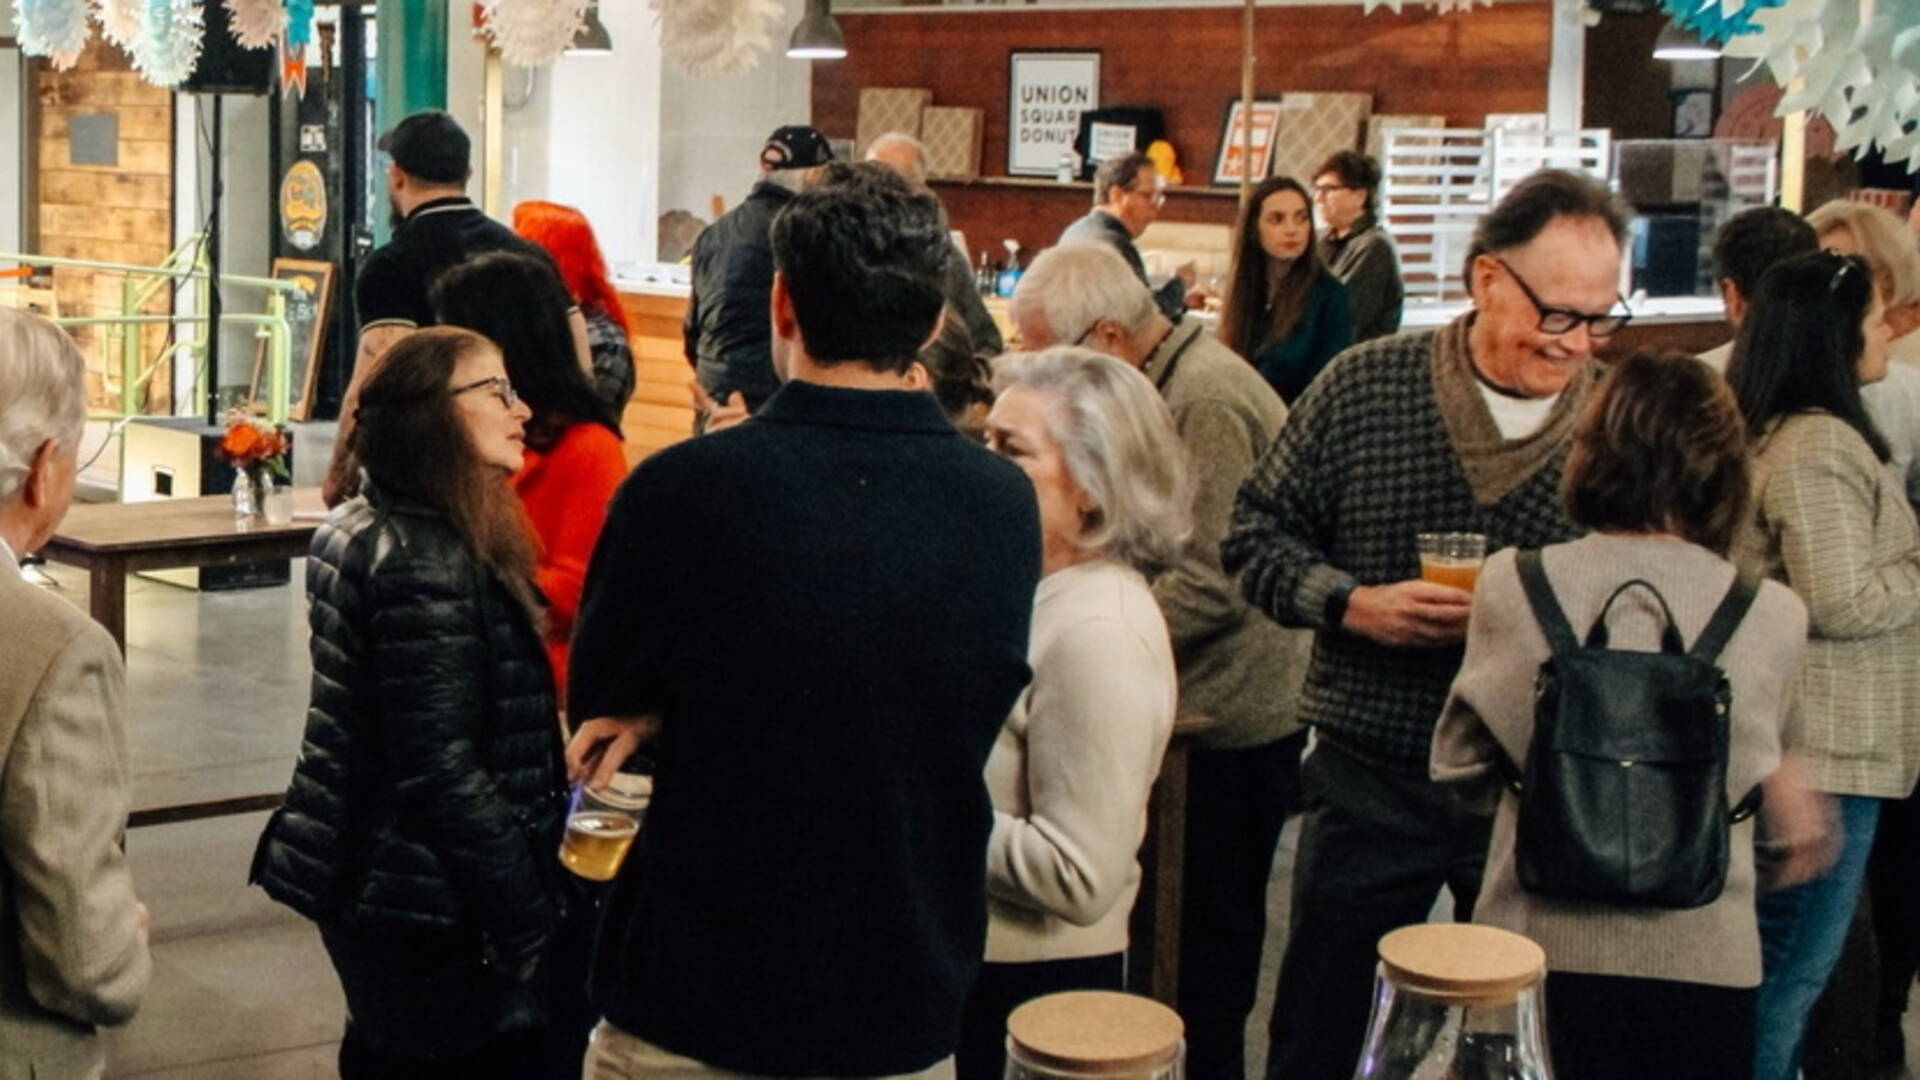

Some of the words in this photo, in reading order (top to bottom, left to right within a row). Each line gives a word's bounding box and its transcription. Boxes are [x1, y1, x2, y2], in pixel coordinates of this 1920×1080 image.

[1021, 85, 1089, 104] UNION
[1020, 109, 1078, 124] SQUAR
[1020, 128, 1077, 145] DONUT
